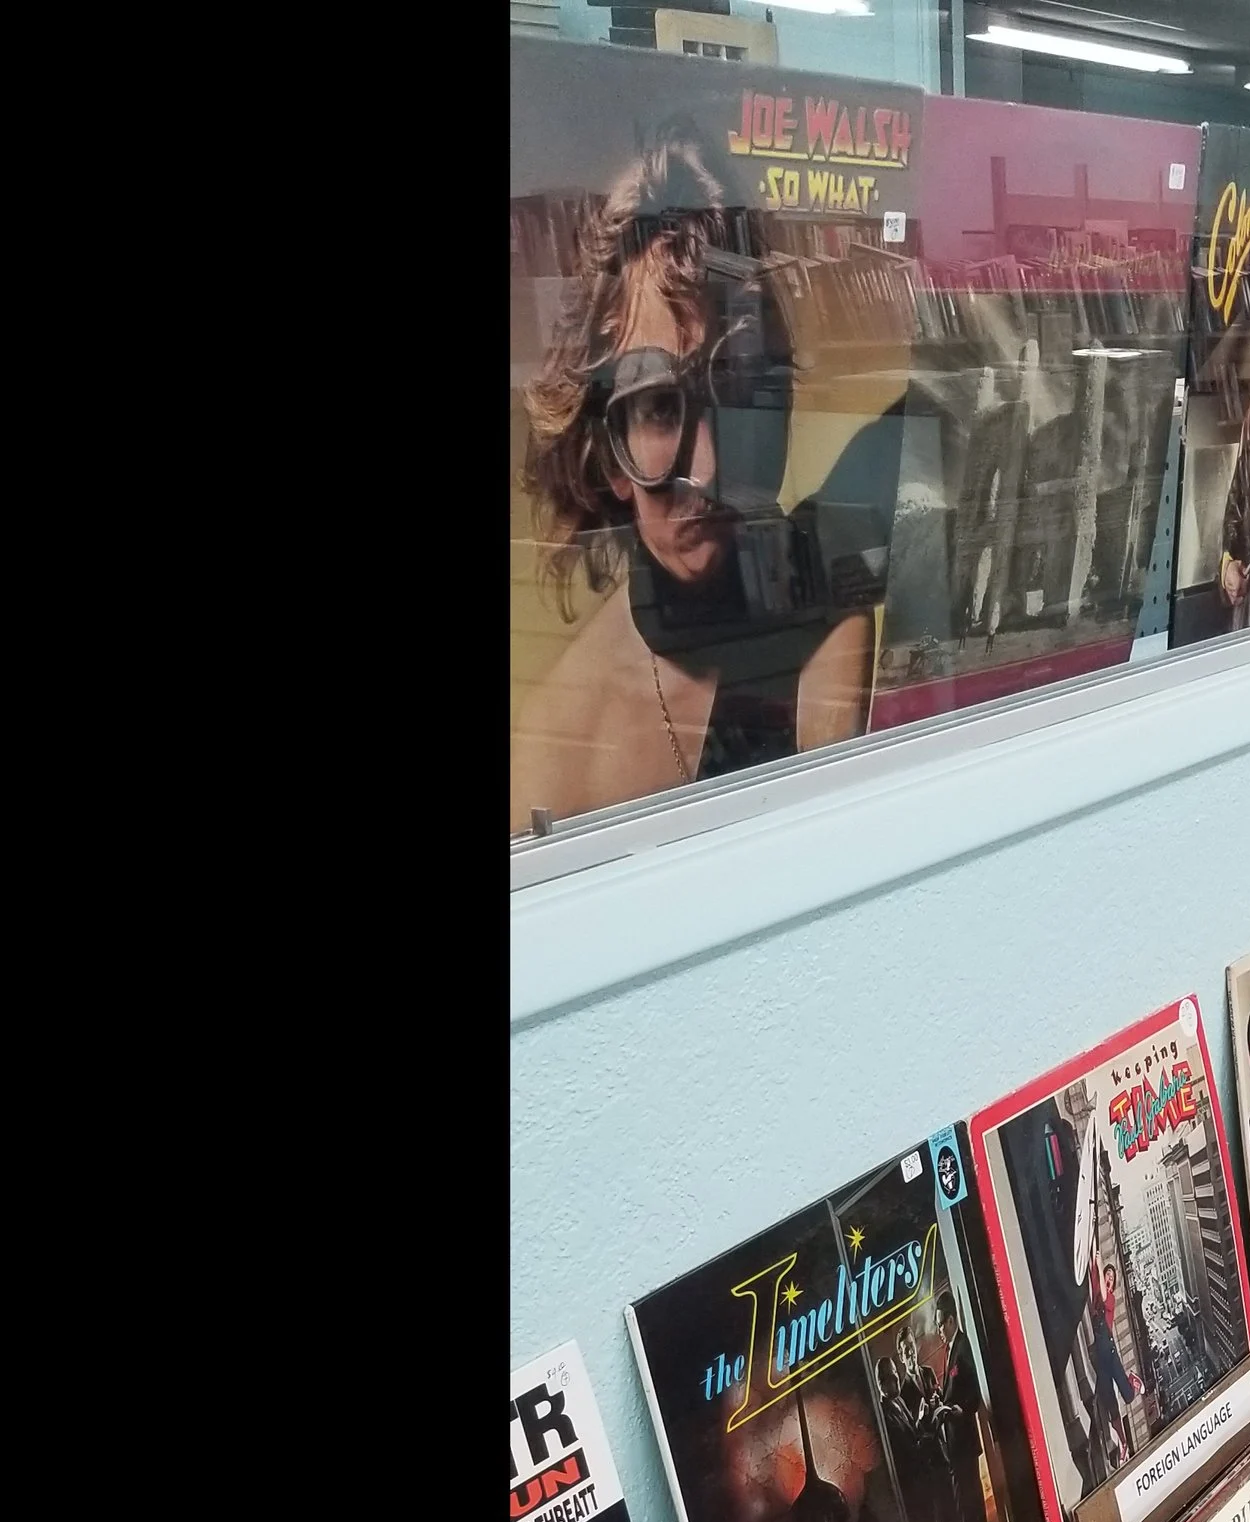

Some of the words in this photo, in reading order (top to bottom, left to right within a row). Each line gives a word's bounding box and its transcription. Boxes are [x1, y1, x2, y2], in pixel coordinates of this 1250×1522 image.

[728, 88, 798, 155] JOE
[804, 96, 912, 168] WALSH
[766, 167, 800, 211] SO
[807, 170, 876, 215] WHAT
[1111, 1039, 1179, 1087] keeping
[699, 1353, 747, 1401] the
[1134, 1449, 1182, 1497] FOREIGN
[1182, 1400, 1234, 1460] LANGUAGE
